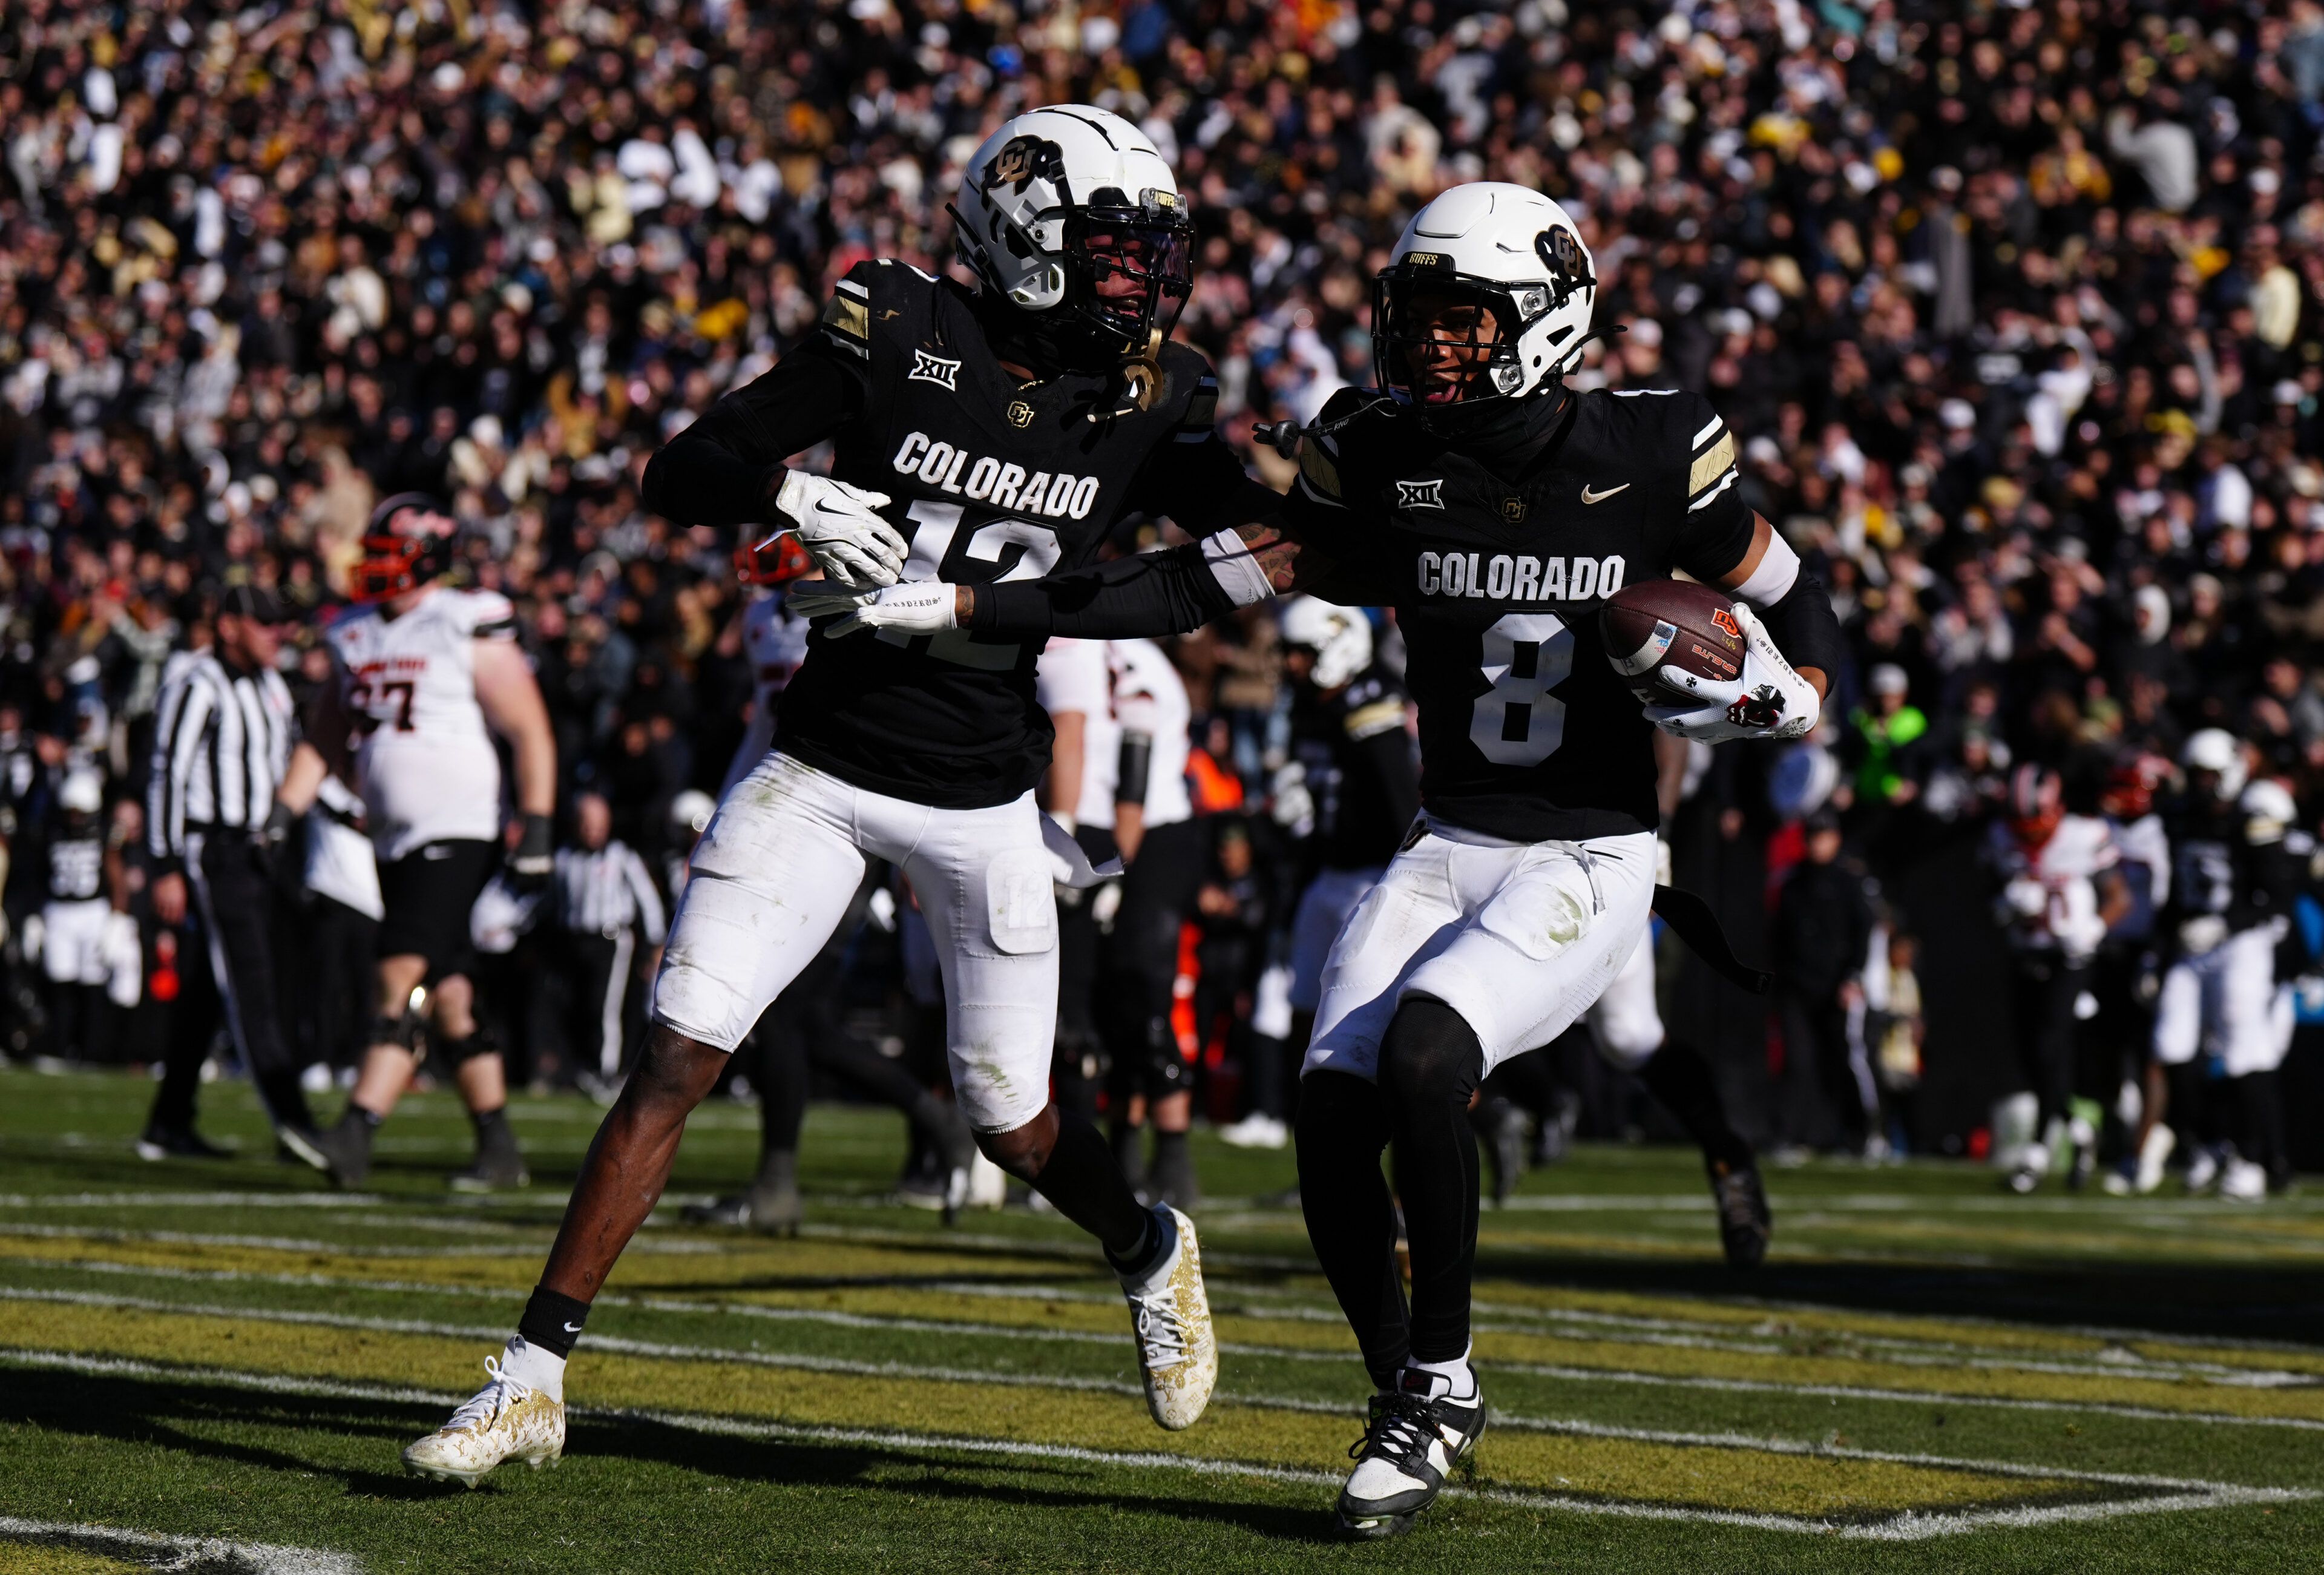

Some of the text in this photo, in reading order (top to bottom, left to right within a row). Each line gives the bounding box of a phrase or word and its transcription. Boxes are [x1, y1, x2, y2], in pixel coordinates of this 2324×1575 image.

[1409, 253, 1438, 266] BUFFS
[893, 431, 1100, 520] COLORADO
[1418, 551, 1626, 600] COLORADO
[1692, 643, 1724, 667] ELITE
[1469, 613, 1575, 768] 8
[1005, 873, 1048, 929] 12
